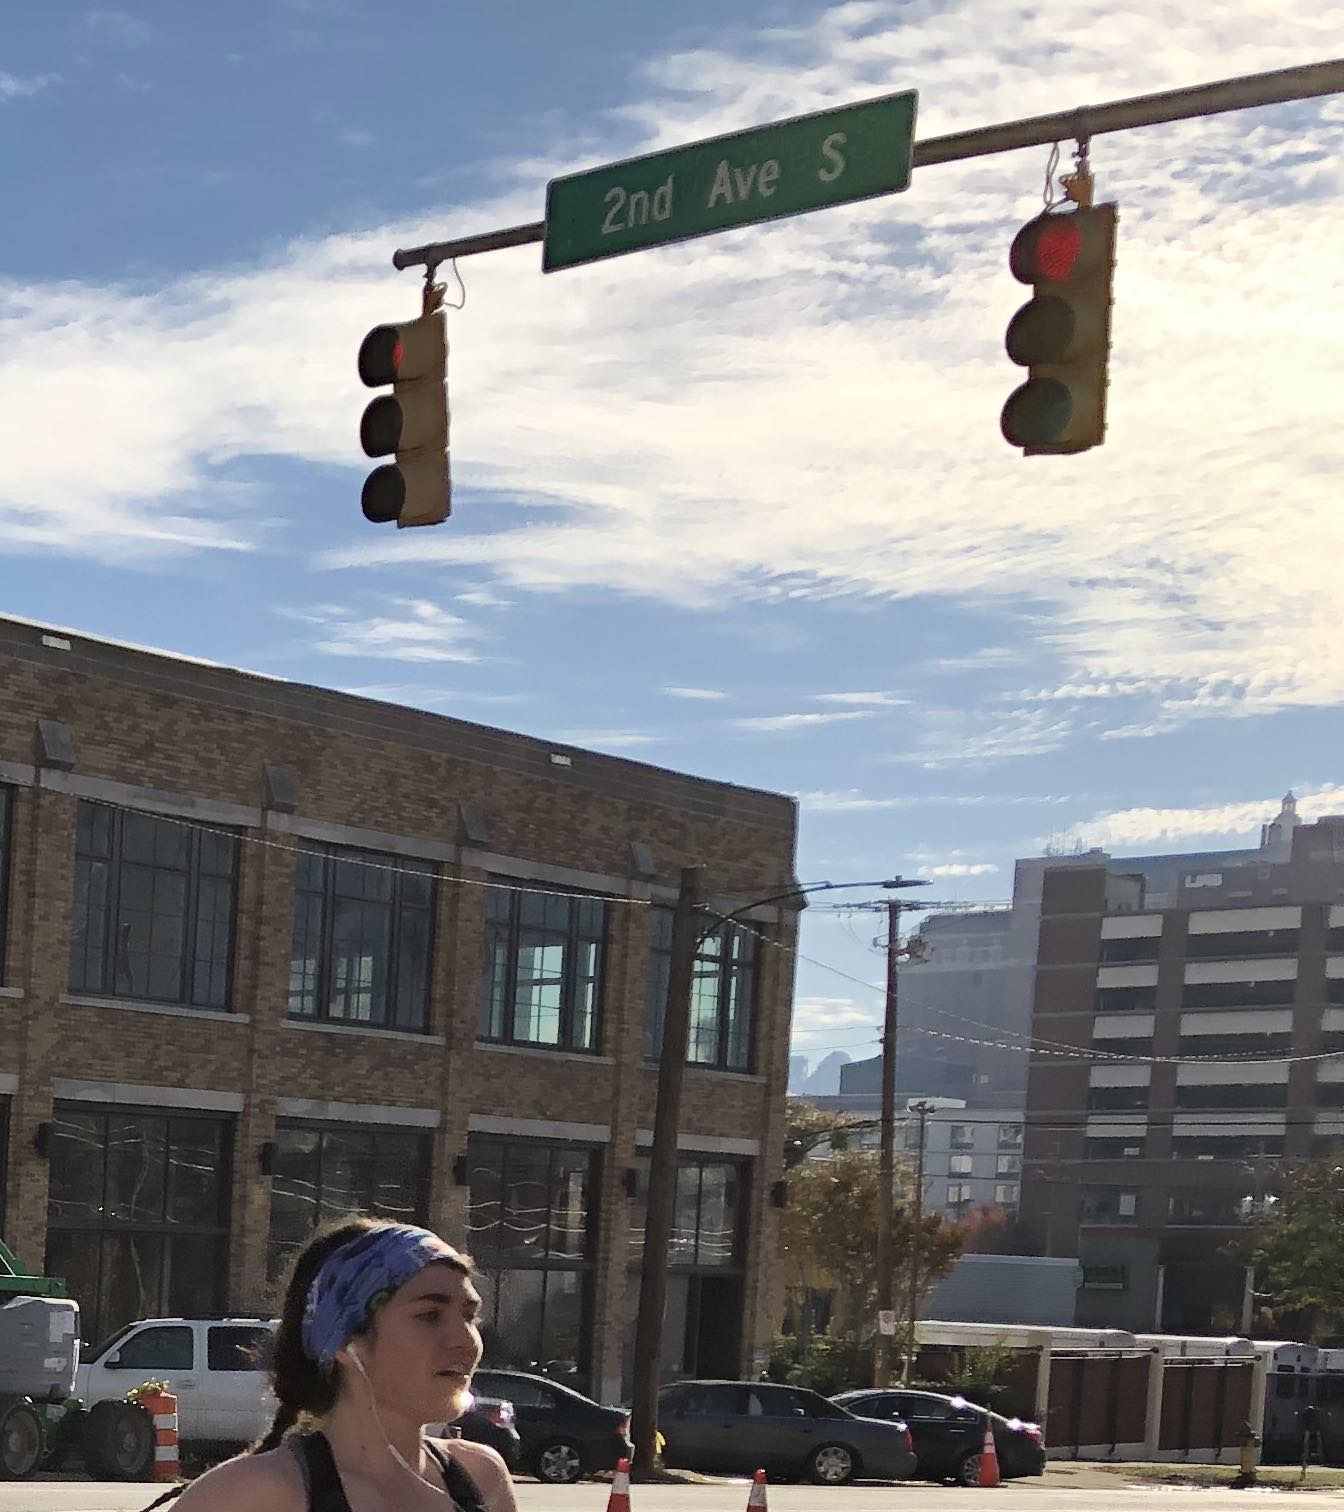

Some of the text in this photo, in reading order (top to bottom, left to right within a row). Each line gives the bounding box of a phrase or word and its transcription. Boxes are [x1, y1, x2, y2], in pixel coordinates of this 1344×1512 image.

[601, 131, 848, 235] 2nd Ave S
